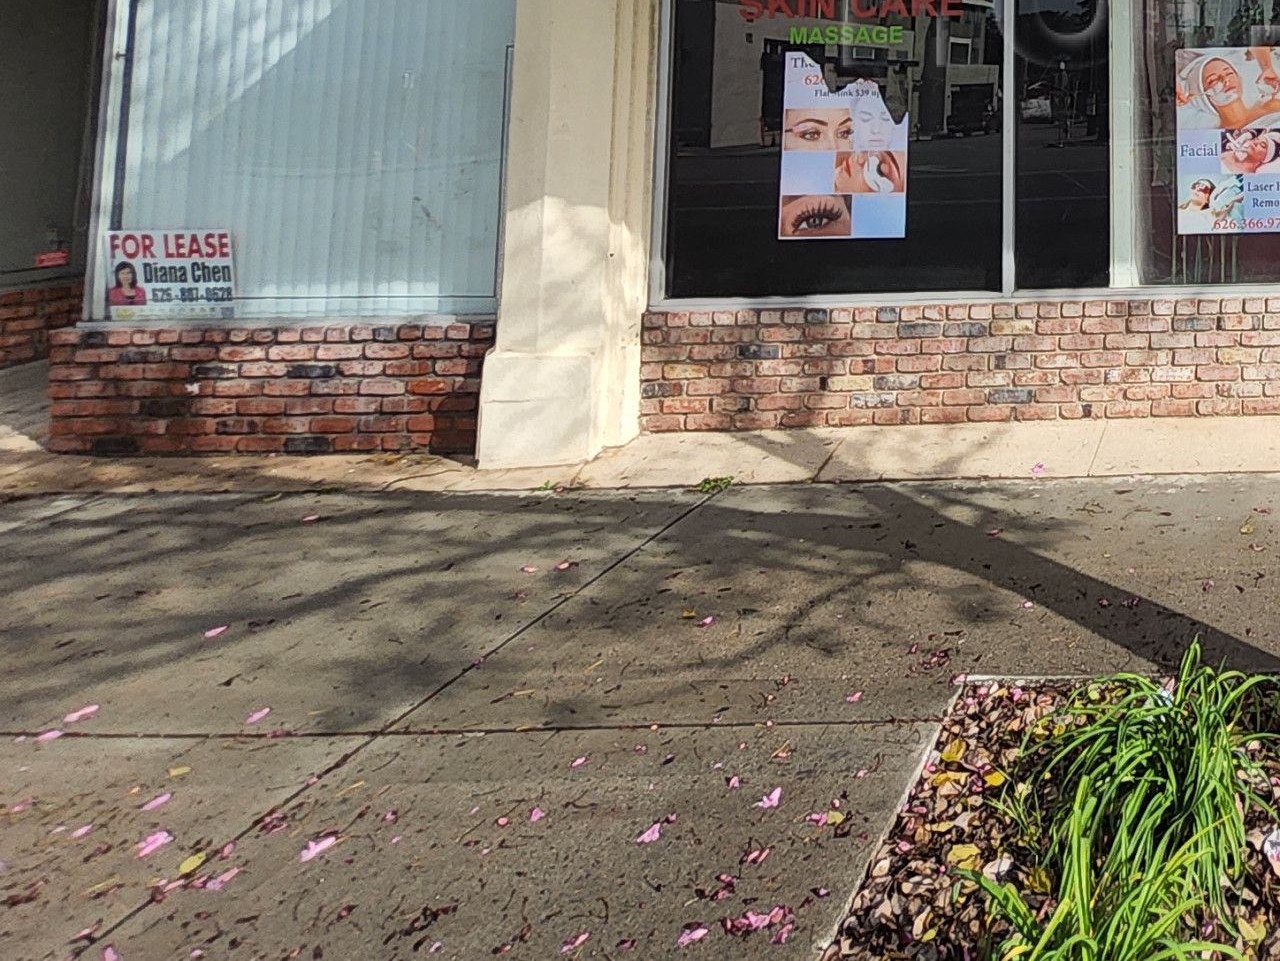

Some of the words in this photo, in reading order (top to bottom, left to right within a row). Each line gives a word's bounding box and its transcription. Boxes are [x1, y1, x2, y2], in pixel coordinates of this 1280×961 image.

[789, 25, 904, 46] MASSAGE
[1180, 143, 1219, 157] Facial
[1247, 181, 1274, 192] Laser
[109, 234, 158, 259] FOR
[163, 232, 230, 258] LEASE
[142, 262, 188, 284] Diana
[190, 261, 232, 283] Chen
